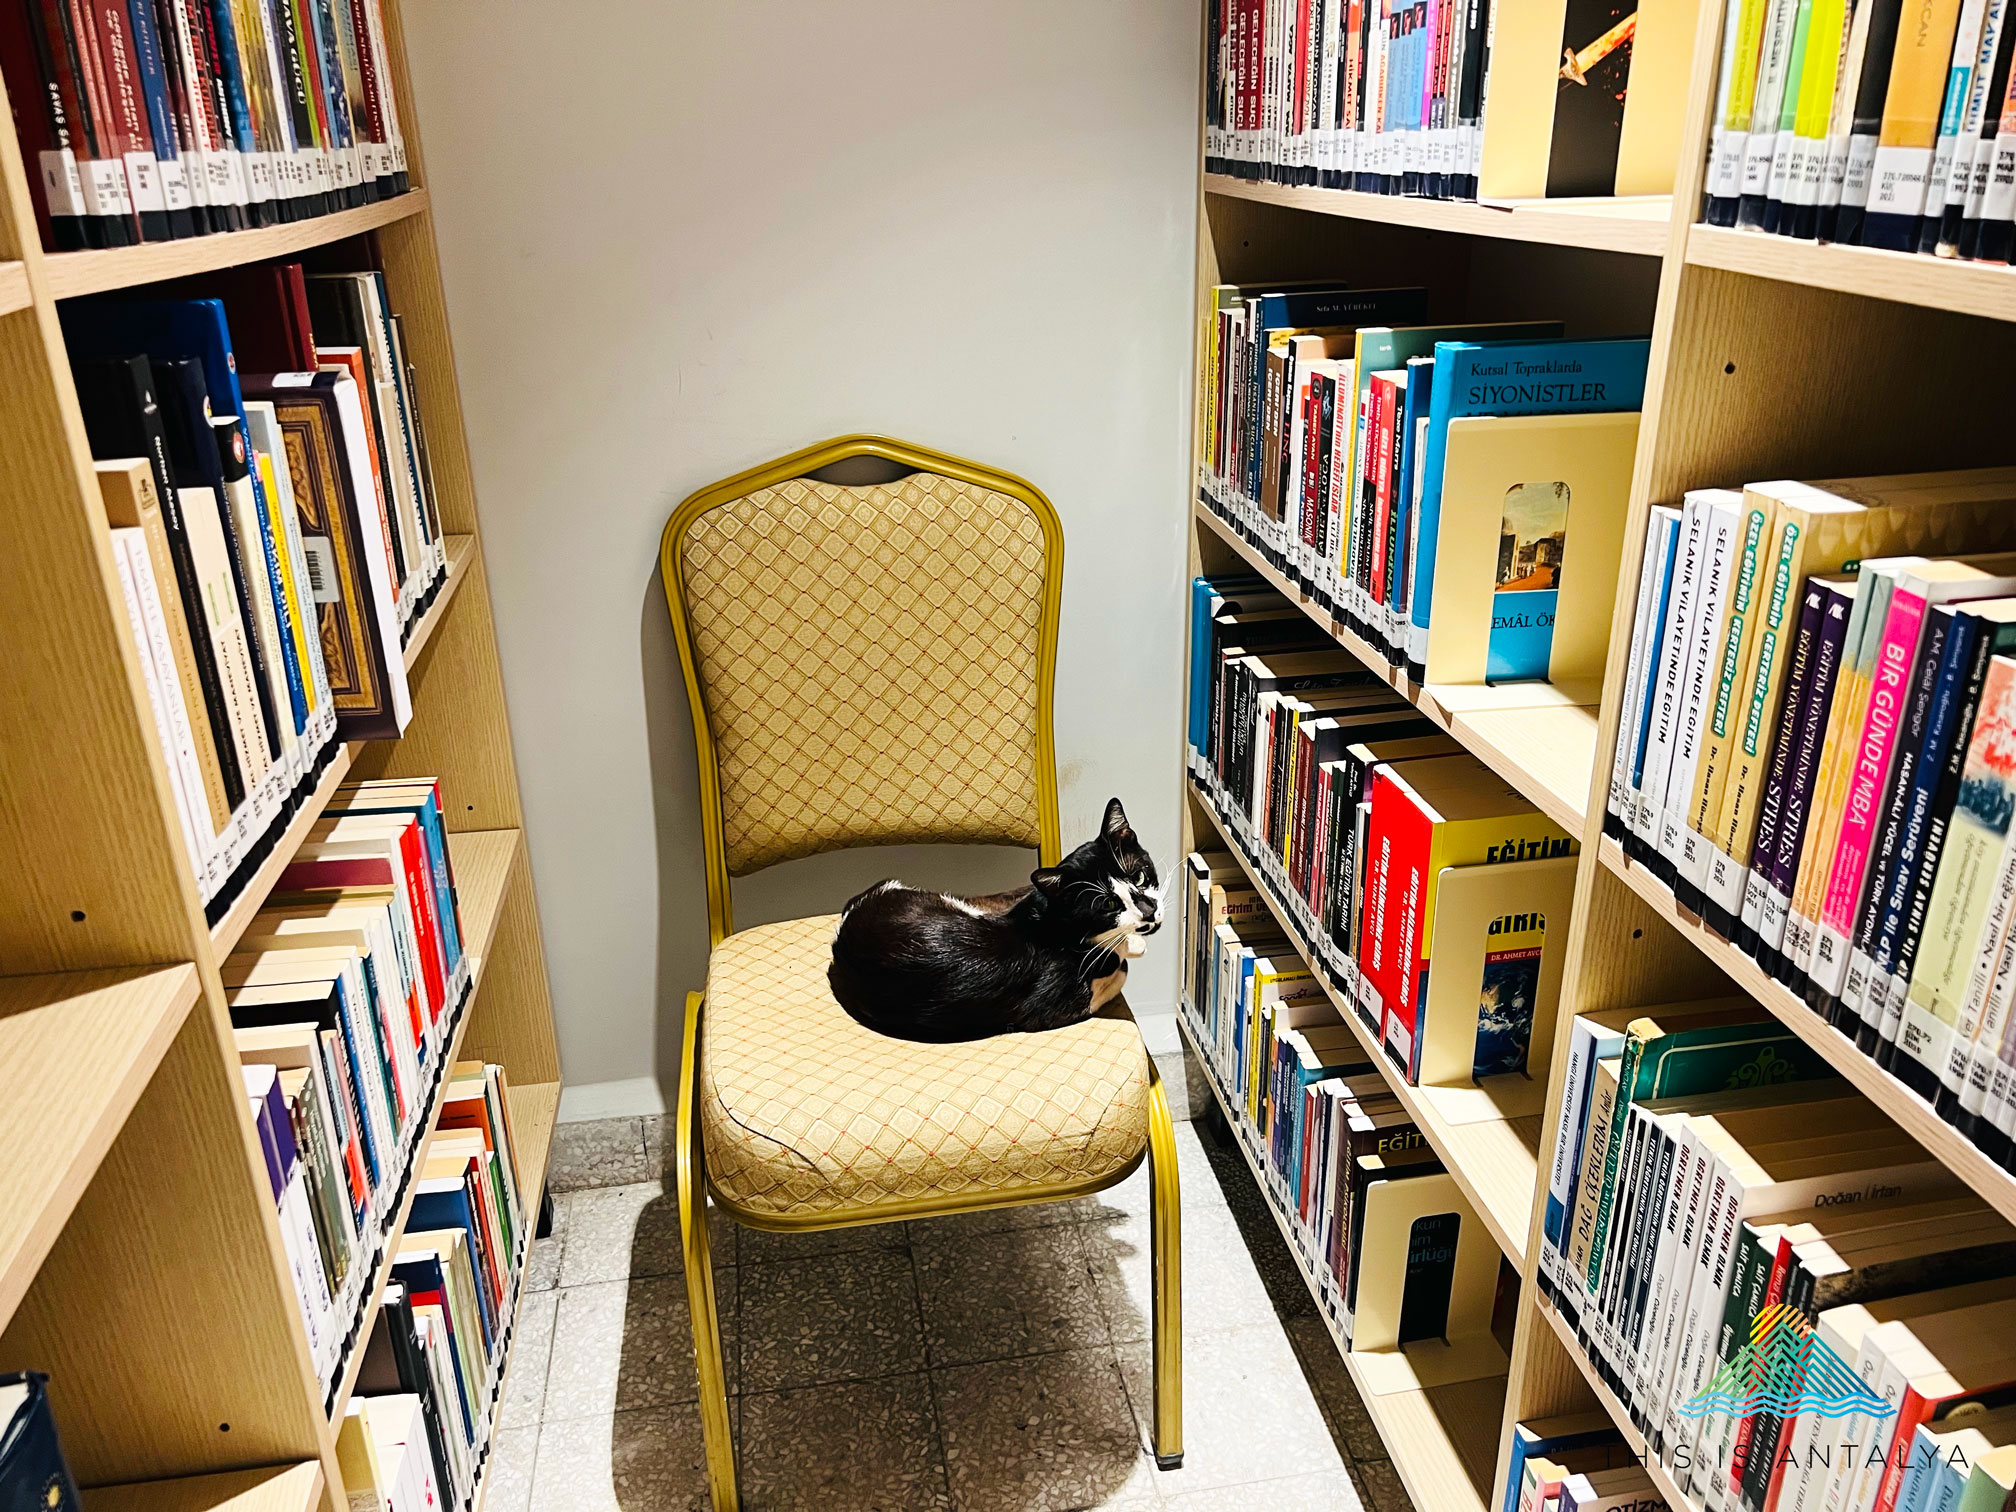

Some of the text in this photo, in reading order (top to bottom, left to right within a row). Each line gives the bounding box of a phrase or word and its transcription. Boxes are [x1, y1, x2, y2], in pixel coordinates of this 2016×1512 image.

[1238, 11, 1246, 90] GELECEĞİN
[1250, 9, 1259, 89] GELECEĞİN
[287, 47, 307, 104] GÜCÜ
[1346, 58, 1354, 104] HİKMET
[1470, 360, 1583, 377] Kutsal Topraklarda
[1250, 381, 1258, 423] İNSANLIK
[1284, 383, 1292, 415] Kaçmaz
[1468, 381, 1607, 407] SİYONİSTLER
[1380, 426, 1389, 457] GİZLİ
[1392, 434, 1400, 471] Marrs
[1320, 452, 1329, 494] LOCA
[1377, 456, 1387, 494] DÜNYA
[165, 484, 180, 532] Atasoy
[1303, 495, 1315, 542] MASONİK
[1746, 510, 1763, 549] ÖZEL
[1780, 523, 1797, 563] ÖZEL
[1791, 626, 1811, 682] EĞİTİM
[1231, 674, 1240, 710] Amerikan
[1713, 681, 1732, 737] DEFTERİ
[1743, 697, 1763, 756] DEFTERİ
[1772, 680, 1801, 782] YÖNETİMİNDE
[1847, 641, 1907, 831] BİR GÜNDE MBA
[1703, 744, 1717, 797] Dr. Hasan
[1777, 638, 1835, 870] EĞİTİM YÖNETİMİNDE STRES
[1733, 763, 1748, 818] Dr. Hasan
[1757, 778, 1782, 856] STRES
[1881, 817, 1900, 862] YÜCEL
[1897, 783, 1929, 863] Serüveni
[1344, 827, 1356, 860] TÜRK
[1486, 839, 1572, 863] EĞİTİM
[1878, 858, 1887, 872] ve
[1916, 813, 1944, 890] SERÜVENİ
[1340, 856, 1354, 897] EĞİTİM
[1367, 858, 1381, 937] DR. AHMET AVCI
[1870, 871, 1885, 906] TÜRK
[1888, 859, 1911, 914] Sınav
[1338, 894, 1351, 933] TARİHİ
[1370, 834, 1393, 973] EĞİTİM BİLİMLERİNE GİRİŞ
[1907, 887, 1927, 935] SINAV
[1395, 889, 1410, 971] DR. AHMET AVCI
[1397, 864, 1422, 1009] EĞİTİM BİLİMLERİNE GİRİŞ
[1981, 925, 1999, 960] Nasıl
[1992, 899, 2008, 925] bir
[1503, 952, 1525, 961] AHMET
[1570, 1049, 1578, 1077] HANGİ
[1564, 1072, 1575, 1116] ÜNİVERSİTE
[1554, 1142, 1565, 1188] ÜNİVERSİTE?
[1577, 1110, 1608, 1243] DAĞ ÇİÇEKLERİM
[1336, 1138, 1354, 1252] EĞİTİM PSİKOLOJİSİ
[1628, 1135, 1656, 1270] YETKİN ÖĞRETMENİN SINIF YÖNETİMİ
[1641, 1148, 1671, 1285] YETKİN ÖĞRETMENİN SINIF YÖNETİMİ
[1666, 1198, 1679, 1236] OLMAK
[1814, 1190, 1862, 1209] Doğan
[1681, 1212, 1695, 1250] OLMAK
[1699, 1232, 1714, 1270] OLMAK
[1738, 1241, 1750, 1264] SAİT
[1711, 1251, 1727, 1290] OLMAK
[1729, 1260, 1748, 1299] ÇAMLICA
[1744, 1261, 1766, 1320] SAİT ÇAMLICA
[1771, 1263, 1786, 1293] Remzi
[1747, 1433, 1763, 1475] DEMİREL
[1757, 1419, 1781, 1491] FATİH DEMİREL
